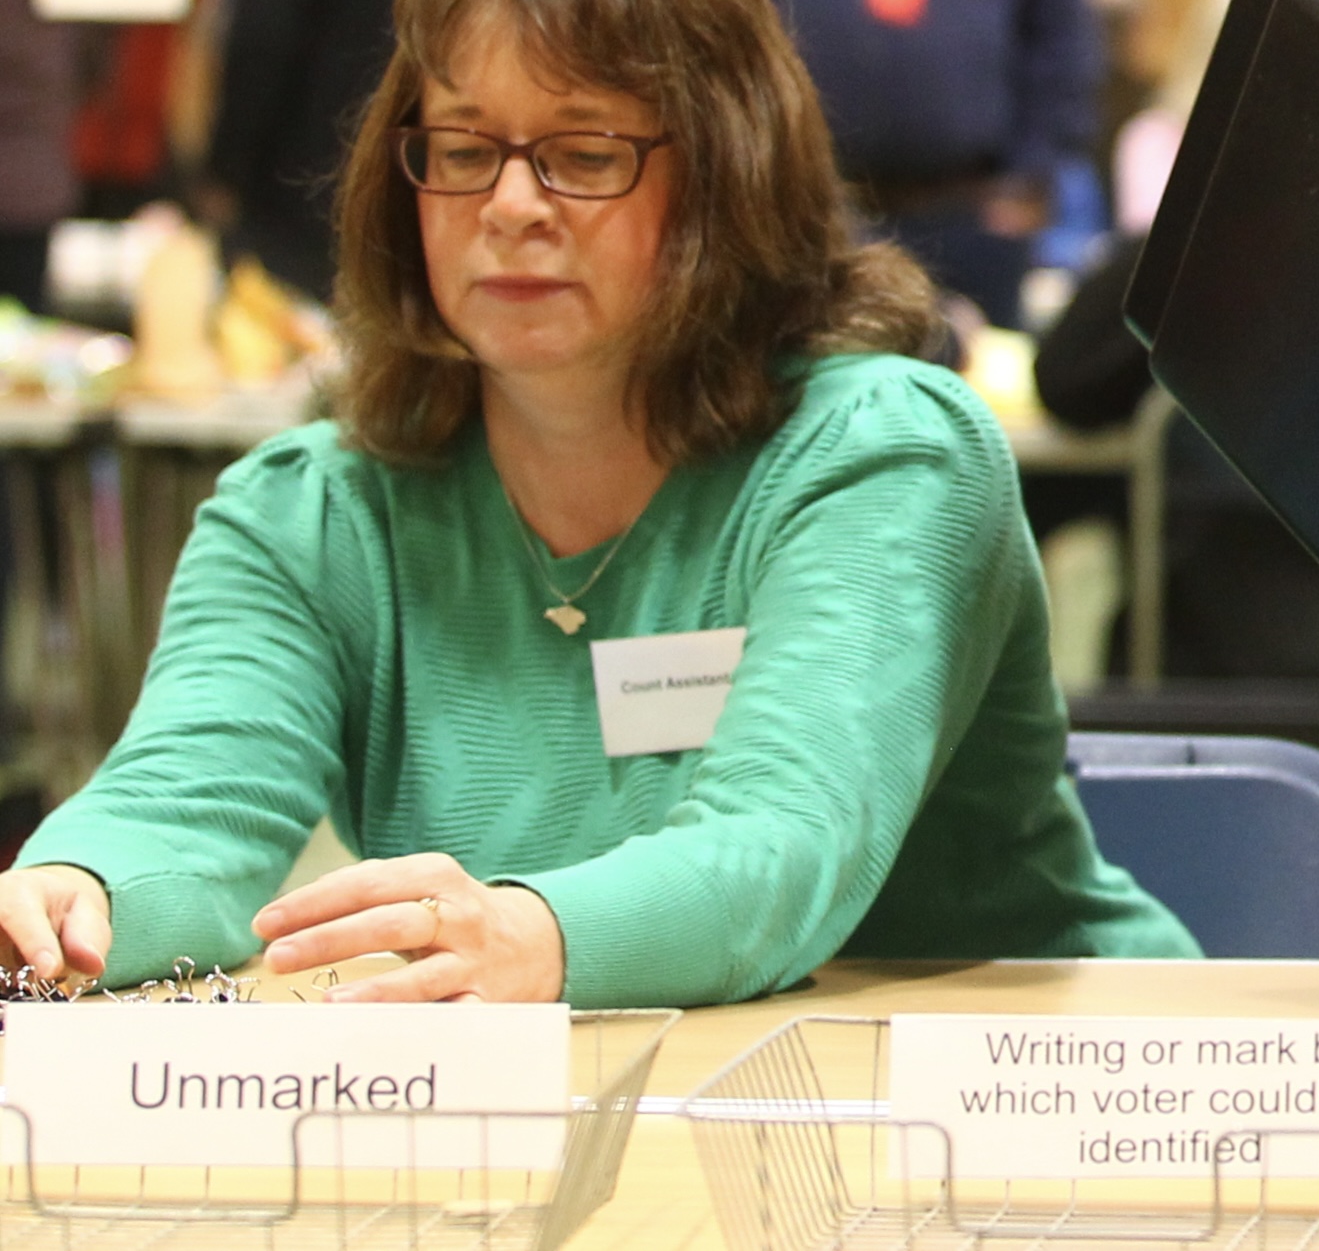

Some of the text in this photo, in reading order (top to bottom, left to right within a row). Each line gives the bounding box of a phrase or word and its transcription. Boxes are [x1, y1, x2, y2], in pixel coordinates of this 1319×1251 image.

[621, 679, 662, 695] Count
[985, 1031, 1126, 1074] Writing
[1141, 1038, 1182, 1066] or
[1197, 1033, 1298, 1066] mark
[129, 1061, 437, 1111] Unmarked
[960, 1082, 1076, 1116] which
[1093, 1084, 1195, 1115] voter
[1209, 1081, 1317, 1115] could
[1079, 1130, 1263, 1165] identified
